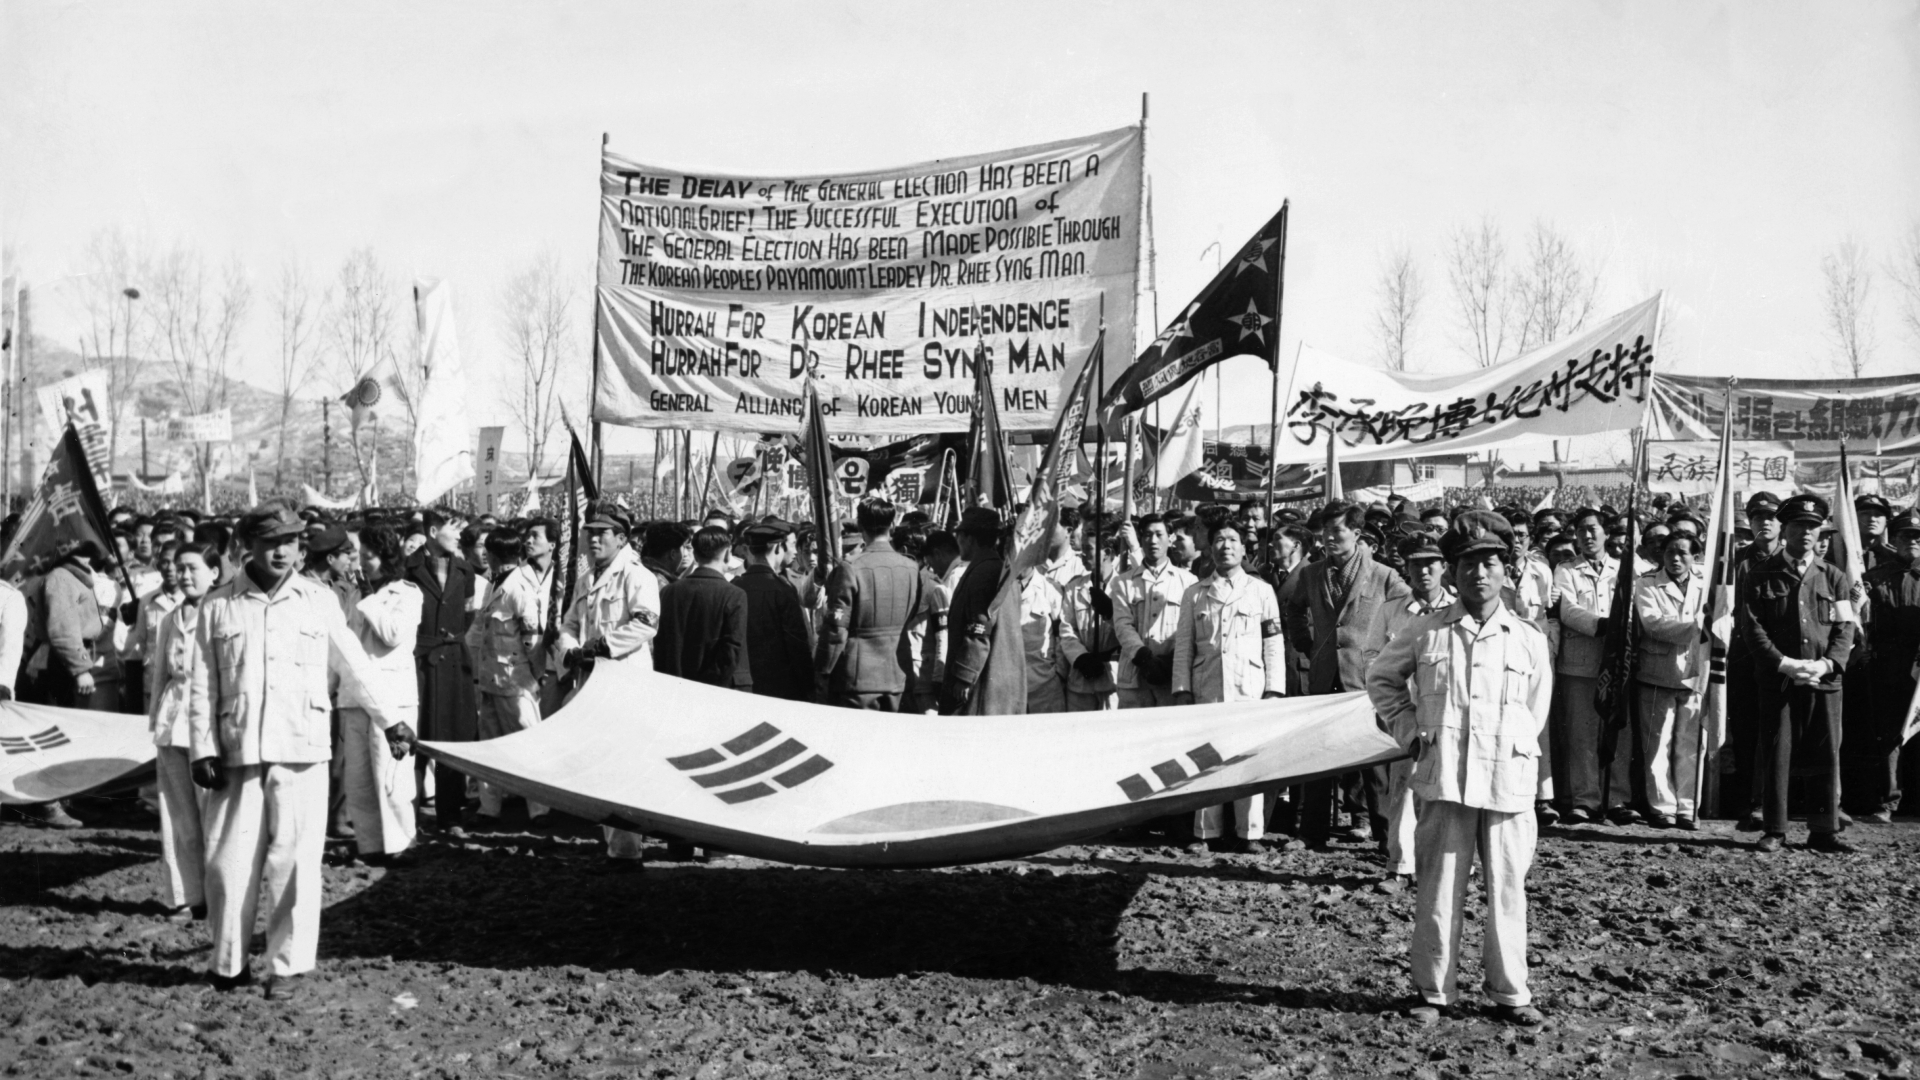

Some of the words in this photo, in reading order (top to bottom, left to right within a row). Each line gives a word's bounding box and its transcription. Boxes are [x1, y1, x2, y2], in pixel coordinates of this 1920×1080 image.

[617, 171, 670, 196] THE
[681, 175, 752, 199] DELAY
[758, 184, 776, 201] of
[784, 180, 811, 201] THE
[818, 179, 884, 201] GENERAL
[894, 170, 967, 199] ELECTION
[979, 163, 1014, 192] HAS
[1023, 159, 1071, 187] BEEN
[1085, 154, 1100, 177] A
[620, 200, 698, 230] NATIONAL
[699, 204, 755, 232] GRIEF!
[763, 206, 797, 230] THE
[804, 203, 901, 229] SUCCESSFUL
[916, 196, 1017, 227] EXECUTION
[1035, 191, 1059, 213] of
[621, 228, 654, 257] THE
[663, 232, 734, 261] GENERAL
[742, 236, 823, 261] ELECTION
[828, 232, 861, 261] HAS
[868, 237, 908, 260] BEEN
[923, 230, 981, 258] MADE
[1054, 216, 1121, 245] THROUGH
[620, 259, 646, 286] THE
[648, 261, 700, 288] KOREAN
[704, 264, 762, 290] PEOPLES
[930, 260, 953, 287] DR.
[957, 258, 991, 285] RHEE
[995, 254, 1033, 282] SYNG
[1040, 250, 1090, 278] MAN.
[650, 300, 717, 337] HURRAH
[726, 303, 765, 339] FOR
[792, 304, 886, 340] KOREAN
[651, 340, 721, 376] HURRAH
[725, 341, 762, 378] FOR
[789, 343, 825, 380] DR.
[845, 343, 904, 380] RHEE
[1008, 337, 1066, 374] MAN
[650, 389, 714, 413] GENERAL
[735, 391, 806, 416] ALLIANC
[857, 394, 922, 418] KOREAN
[1004, 387, 1048, 412] MEN
[840, 461, 864, 494] 은
[1657, 452, 1788, 487] 民族年團
